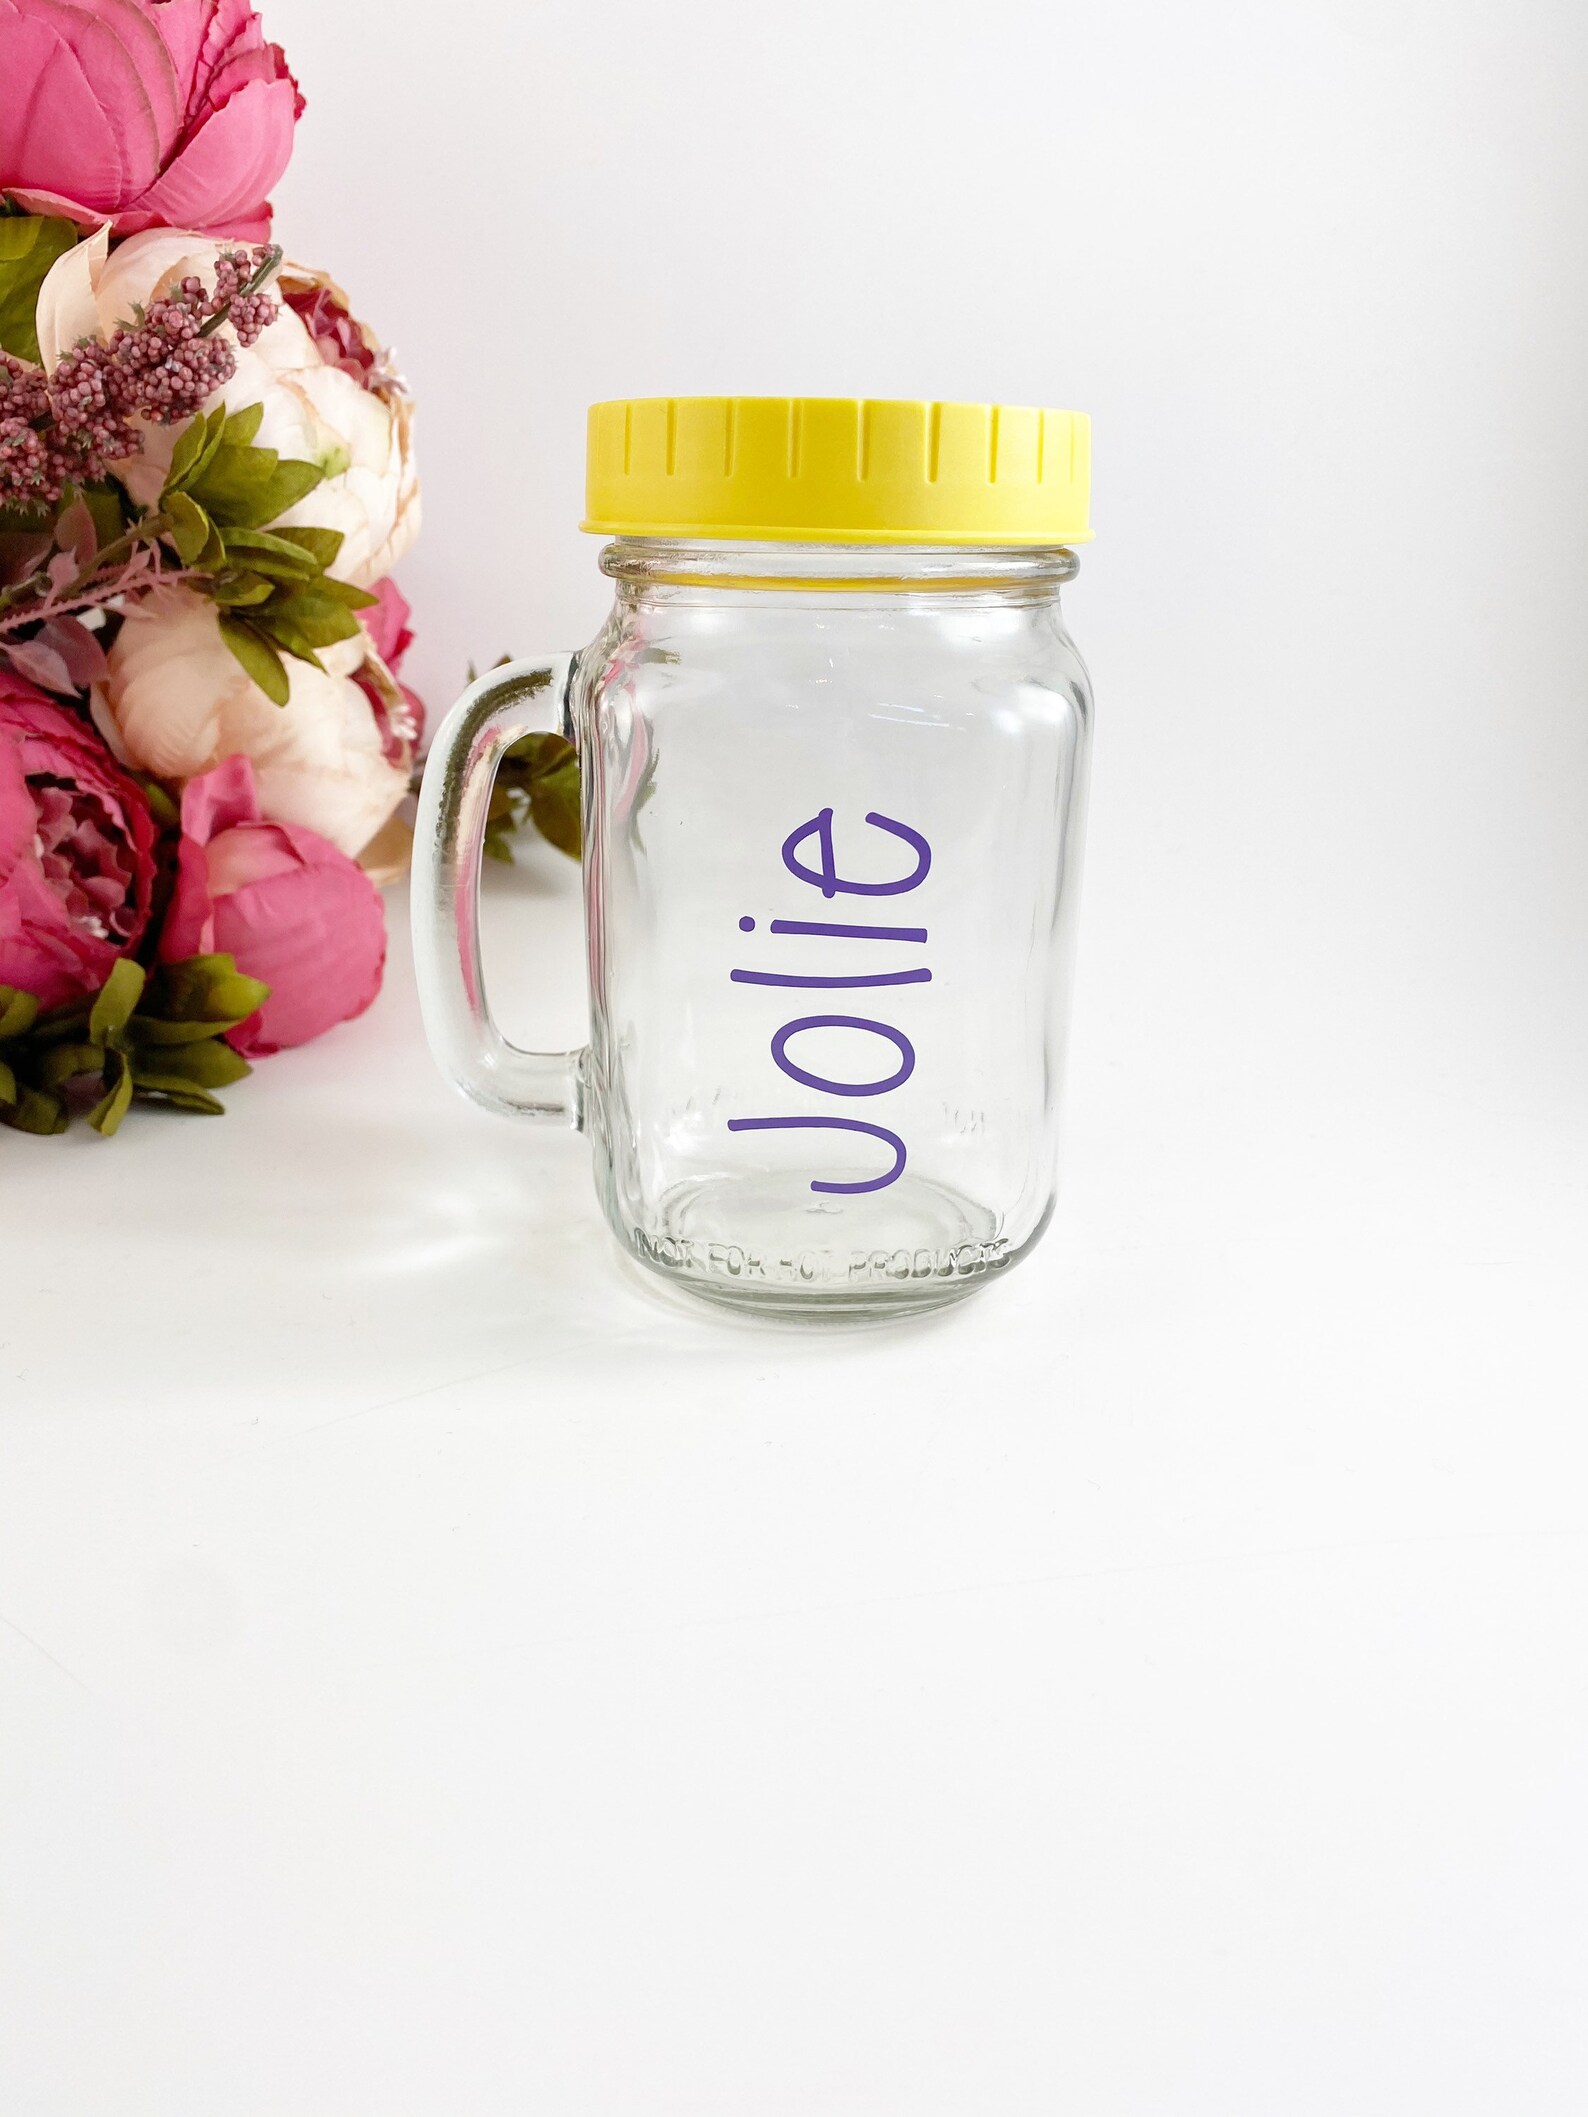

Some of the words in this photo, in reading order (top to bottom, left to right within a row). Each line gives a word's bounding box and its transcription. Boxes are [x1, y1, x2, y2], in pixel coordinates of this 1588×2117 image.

[727, 807, 932, 1194] Jolie
[634, 1227, 695, 1268] NOT
[707, 1243, 766, 1276] FOR
